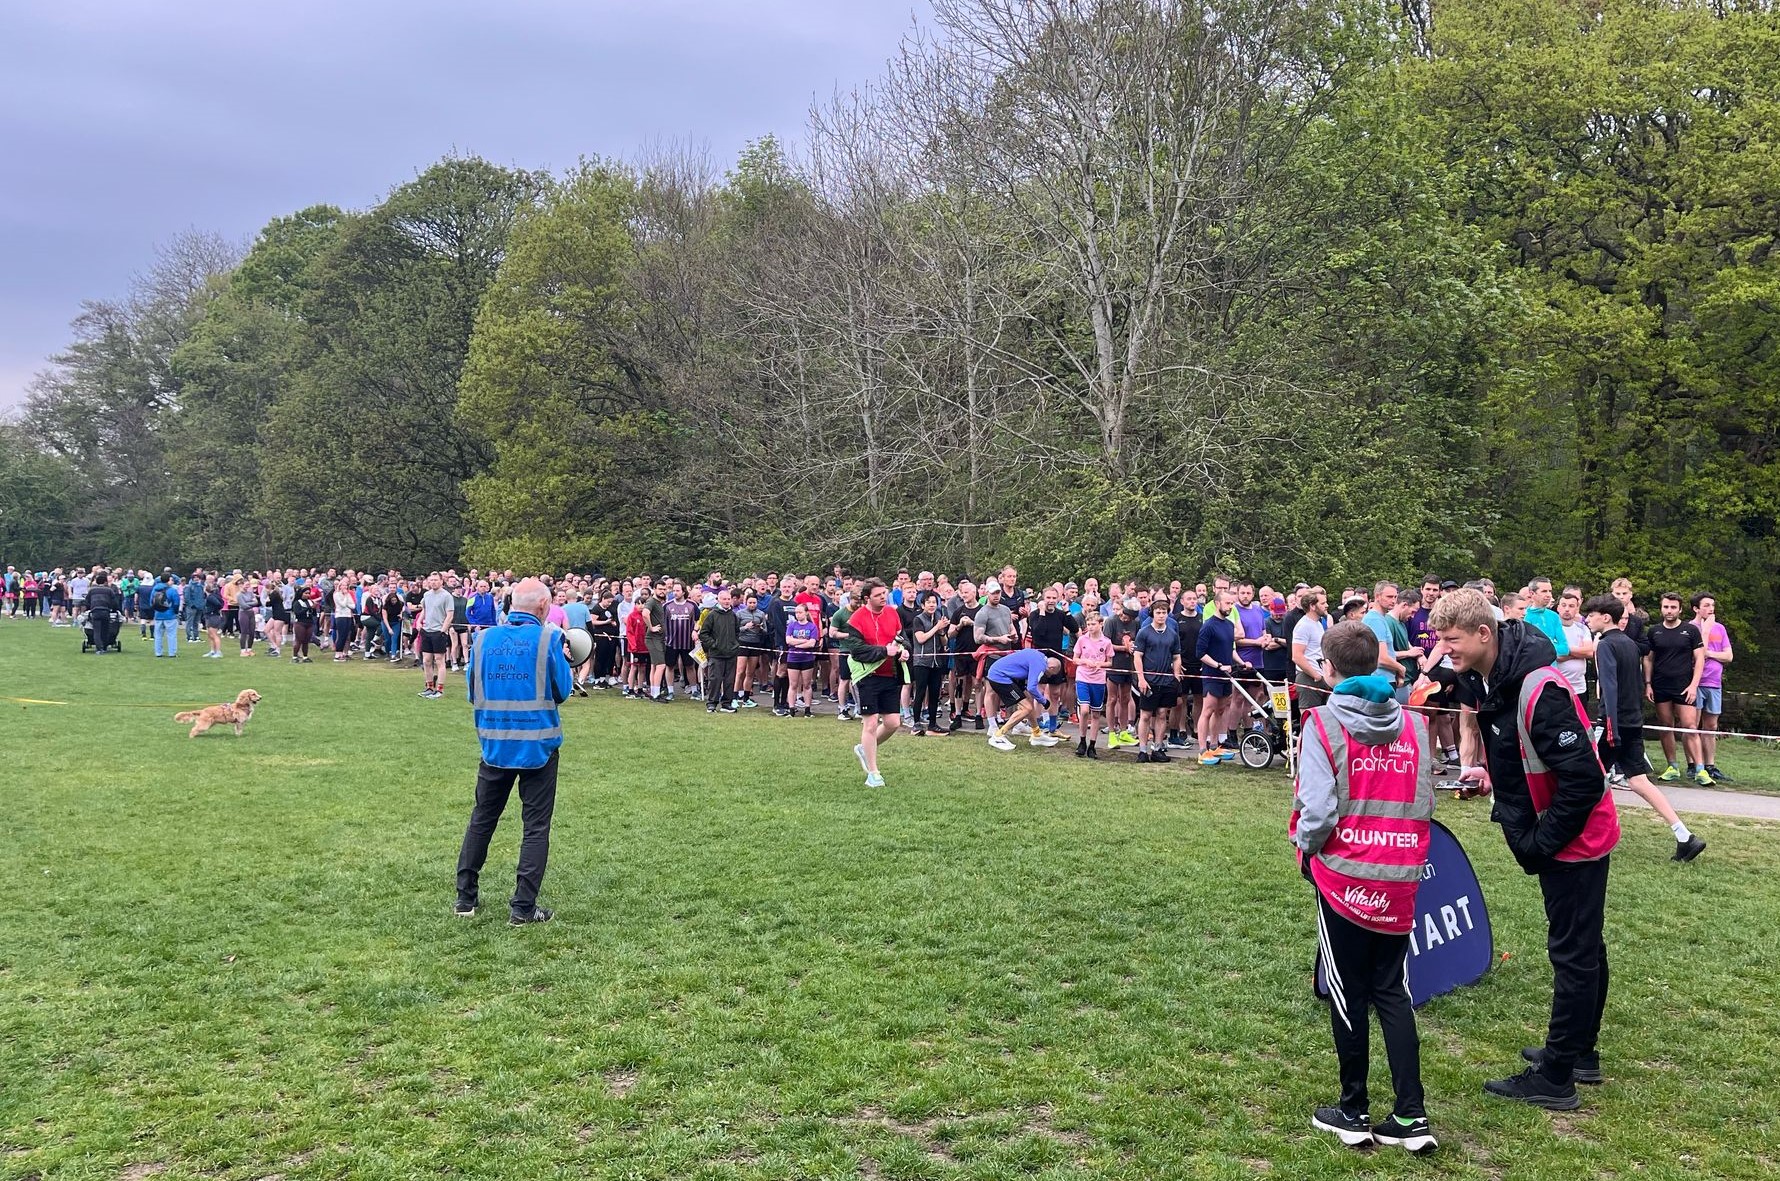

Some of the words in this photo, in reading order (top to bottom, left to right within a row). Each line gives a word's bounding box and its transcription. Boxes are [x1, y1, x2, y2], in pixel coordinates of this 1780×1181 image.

[488, 673, 529, 681] DIRECTOR
[498, 664, 516, 672] RUN
[1275, 697, 1287, 707] 20
[1389, 740, 1415, 759] Vitality
[1351, 749, 1415, 776] parkrun
[1345, 885, 1391, 913] Vitality
[1409, 895, 1474, 956] TART
